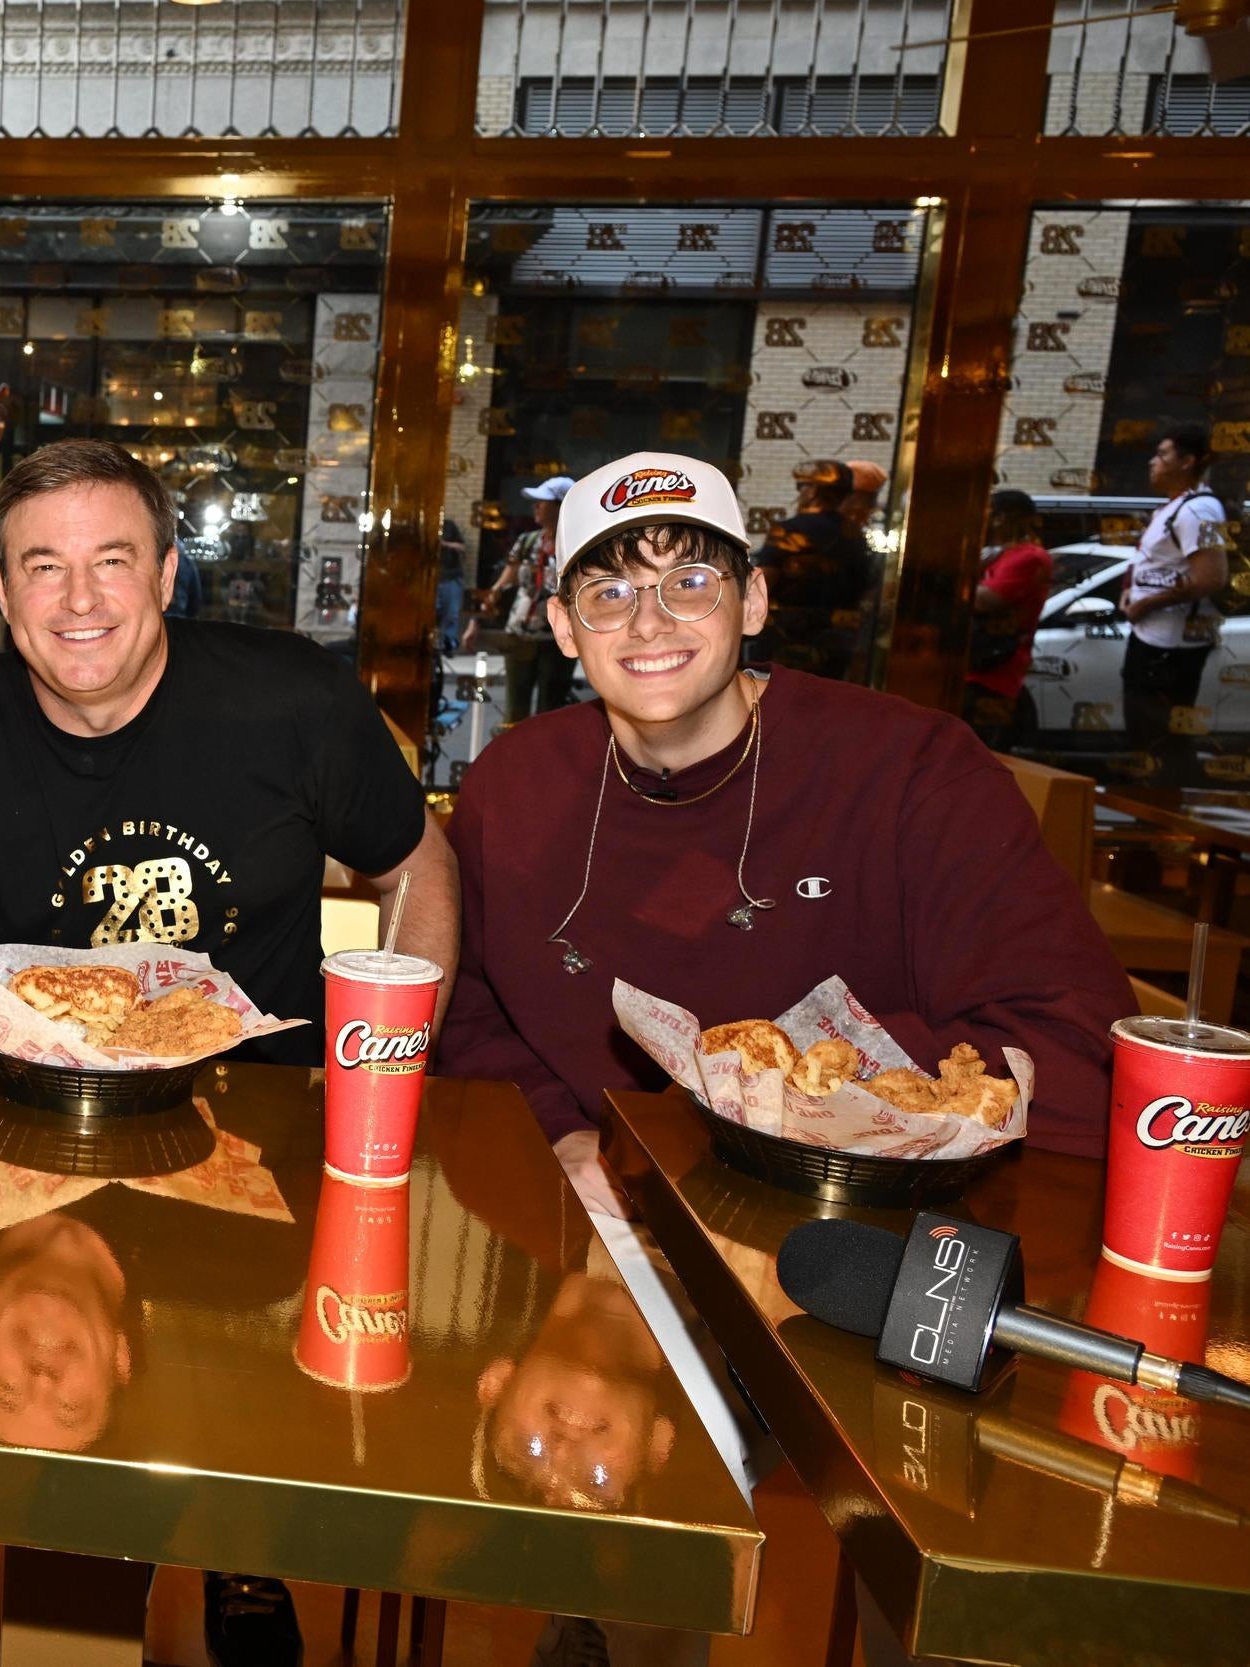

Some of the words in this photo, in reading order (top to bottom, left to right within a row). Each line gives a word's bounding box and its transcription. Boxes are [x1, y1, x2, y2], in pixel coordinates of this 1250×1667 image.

[605, 469, 693, 512] Cane's
[51, 827, 111, 908] GLDEN
[122, 820, 232, 884] BIRTHDAY
[82, 857, 200, 948] 28
[335, 1020, 430, 1067] Cane's
[374, 1024, 415, 1035] Raising
[1136, 1096, 1250, 1147] Cane
[1195, 1102, 1244, 1116] Raising
[1184, 1145, 1223, 1156] CHICKEN
[910, 1237, 965, 1365] CLNS
[942, 1321, 959, 1366] MEDIA
[955, 1249, 980, 1312] NETWORK
